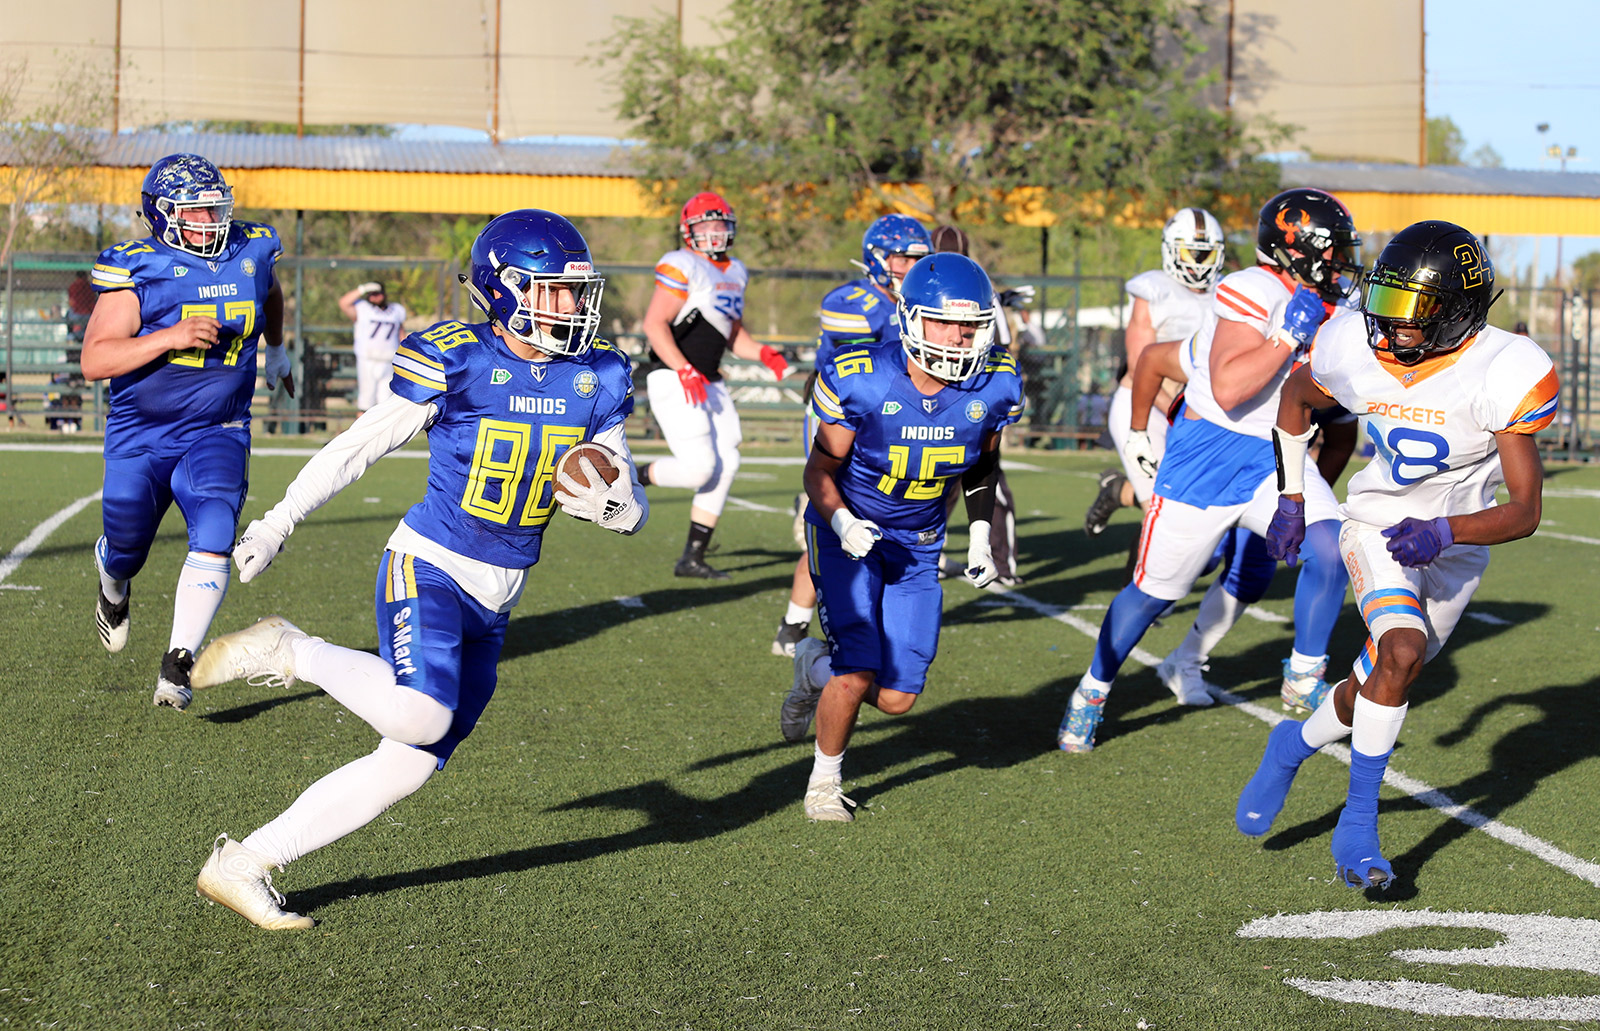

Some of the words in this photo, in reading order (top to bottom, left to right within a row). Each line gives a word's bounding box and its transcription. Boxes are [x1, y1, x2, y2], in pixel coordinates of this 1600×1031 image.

[198, 283, 238, 299] INDIOS
[846, 286, 880, 312] 74
[370, 320, 395, 340] 77
[421, 321, 479, 353] 88
[834, 349, 873, 379] 16
[509, 395, 567, 415] INDIOS
[1366, 402, 1446, 425] ROCKETS
[901, 426, 955, 440] INDIOS
[603, 502, 628, 521] adidas
